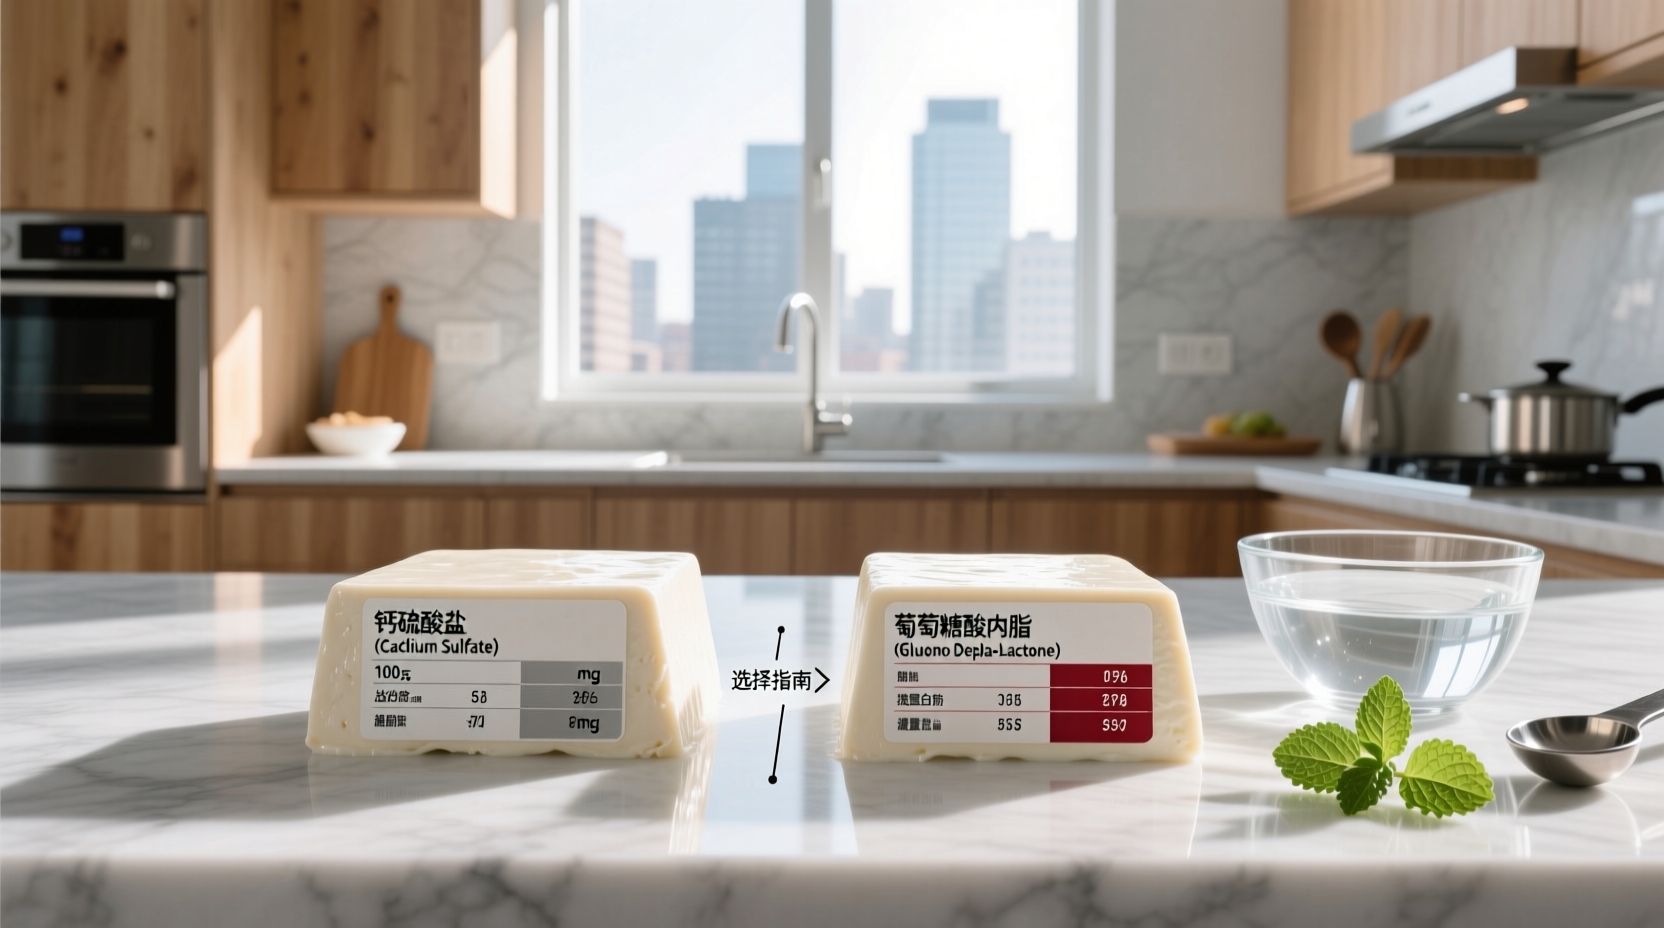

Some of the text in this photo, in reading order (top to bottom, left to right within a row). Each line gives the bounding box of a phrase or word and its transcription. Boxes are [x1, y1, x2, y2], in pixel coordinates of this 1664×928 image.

[374, 608, 467, 635] 钙硫酸盐
[441, 637, 499, 657] Sulfate)
[894, 642, 950, 658] (Gluono
[577, 669, 601, 685] mg
